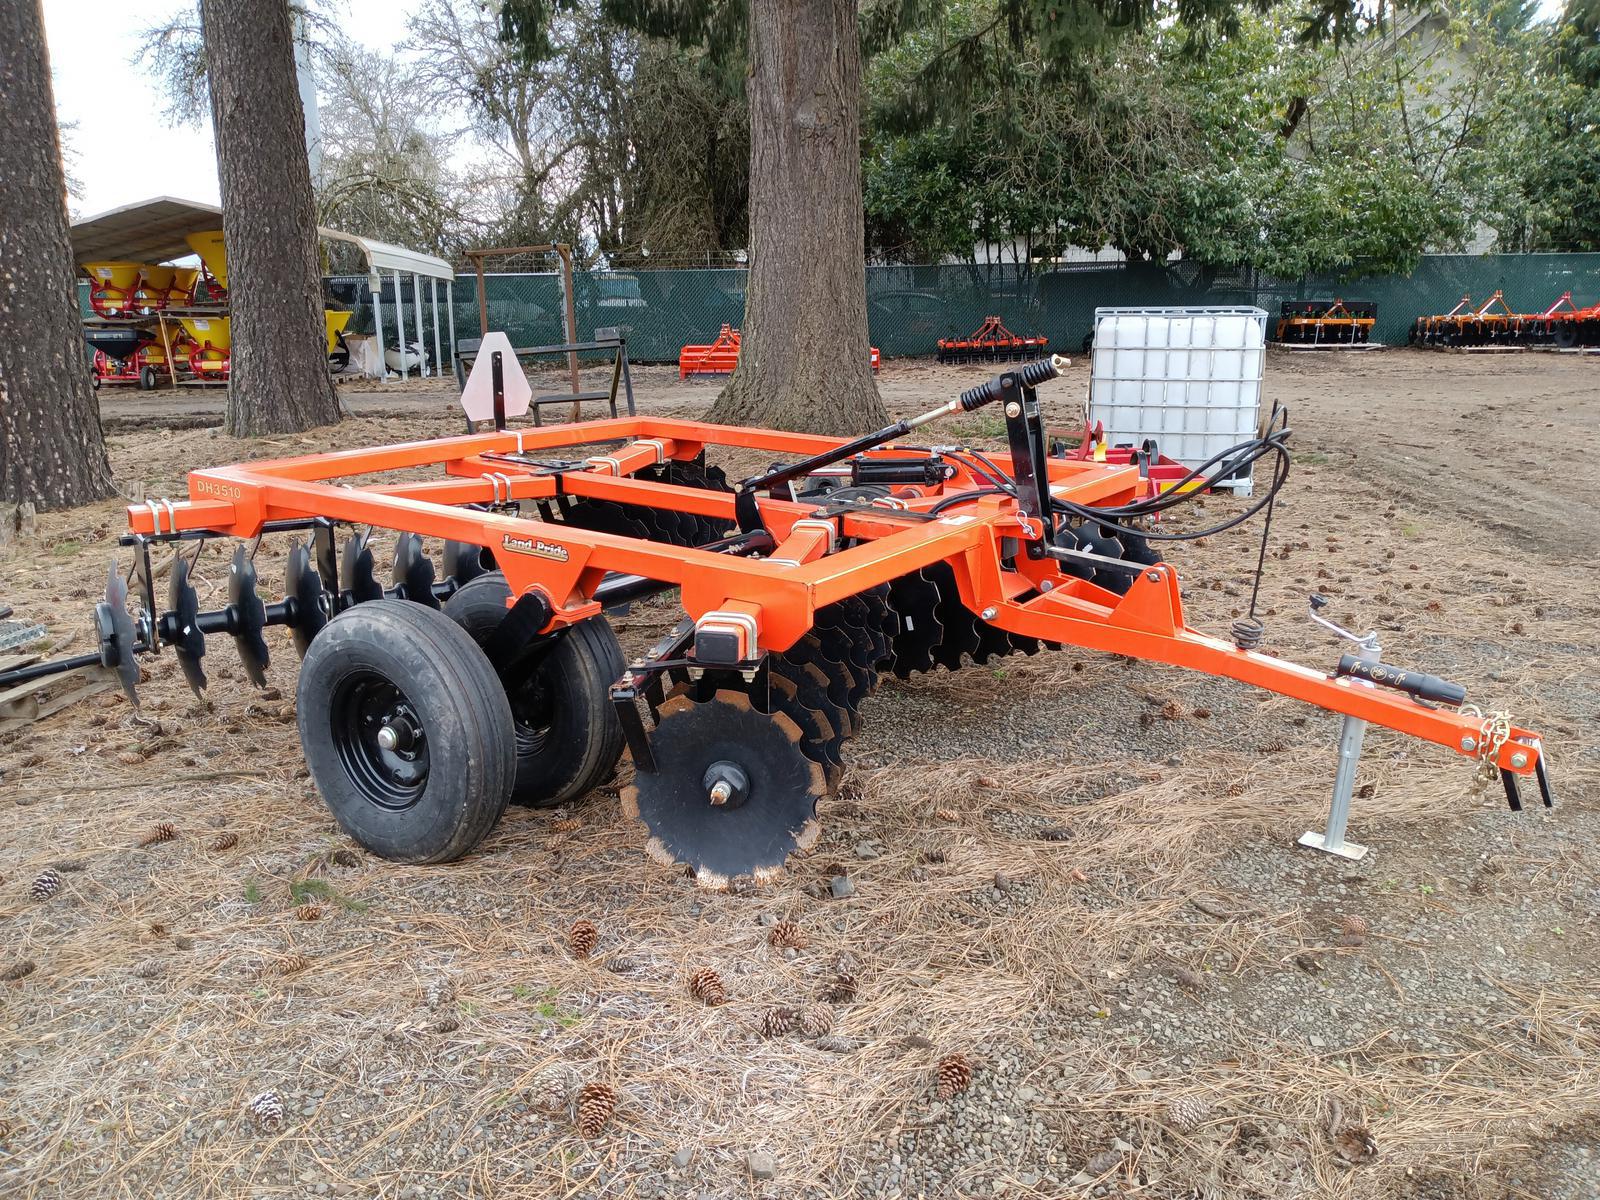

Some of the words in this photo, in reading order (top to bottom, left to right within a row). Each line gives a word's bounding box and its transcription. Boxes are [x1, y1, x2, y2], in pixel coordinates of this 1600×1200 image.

[197, 480, 241, 499] DH3510
[504, 534, 532, 549] Land
[536, 541, 568, 556] Pride
